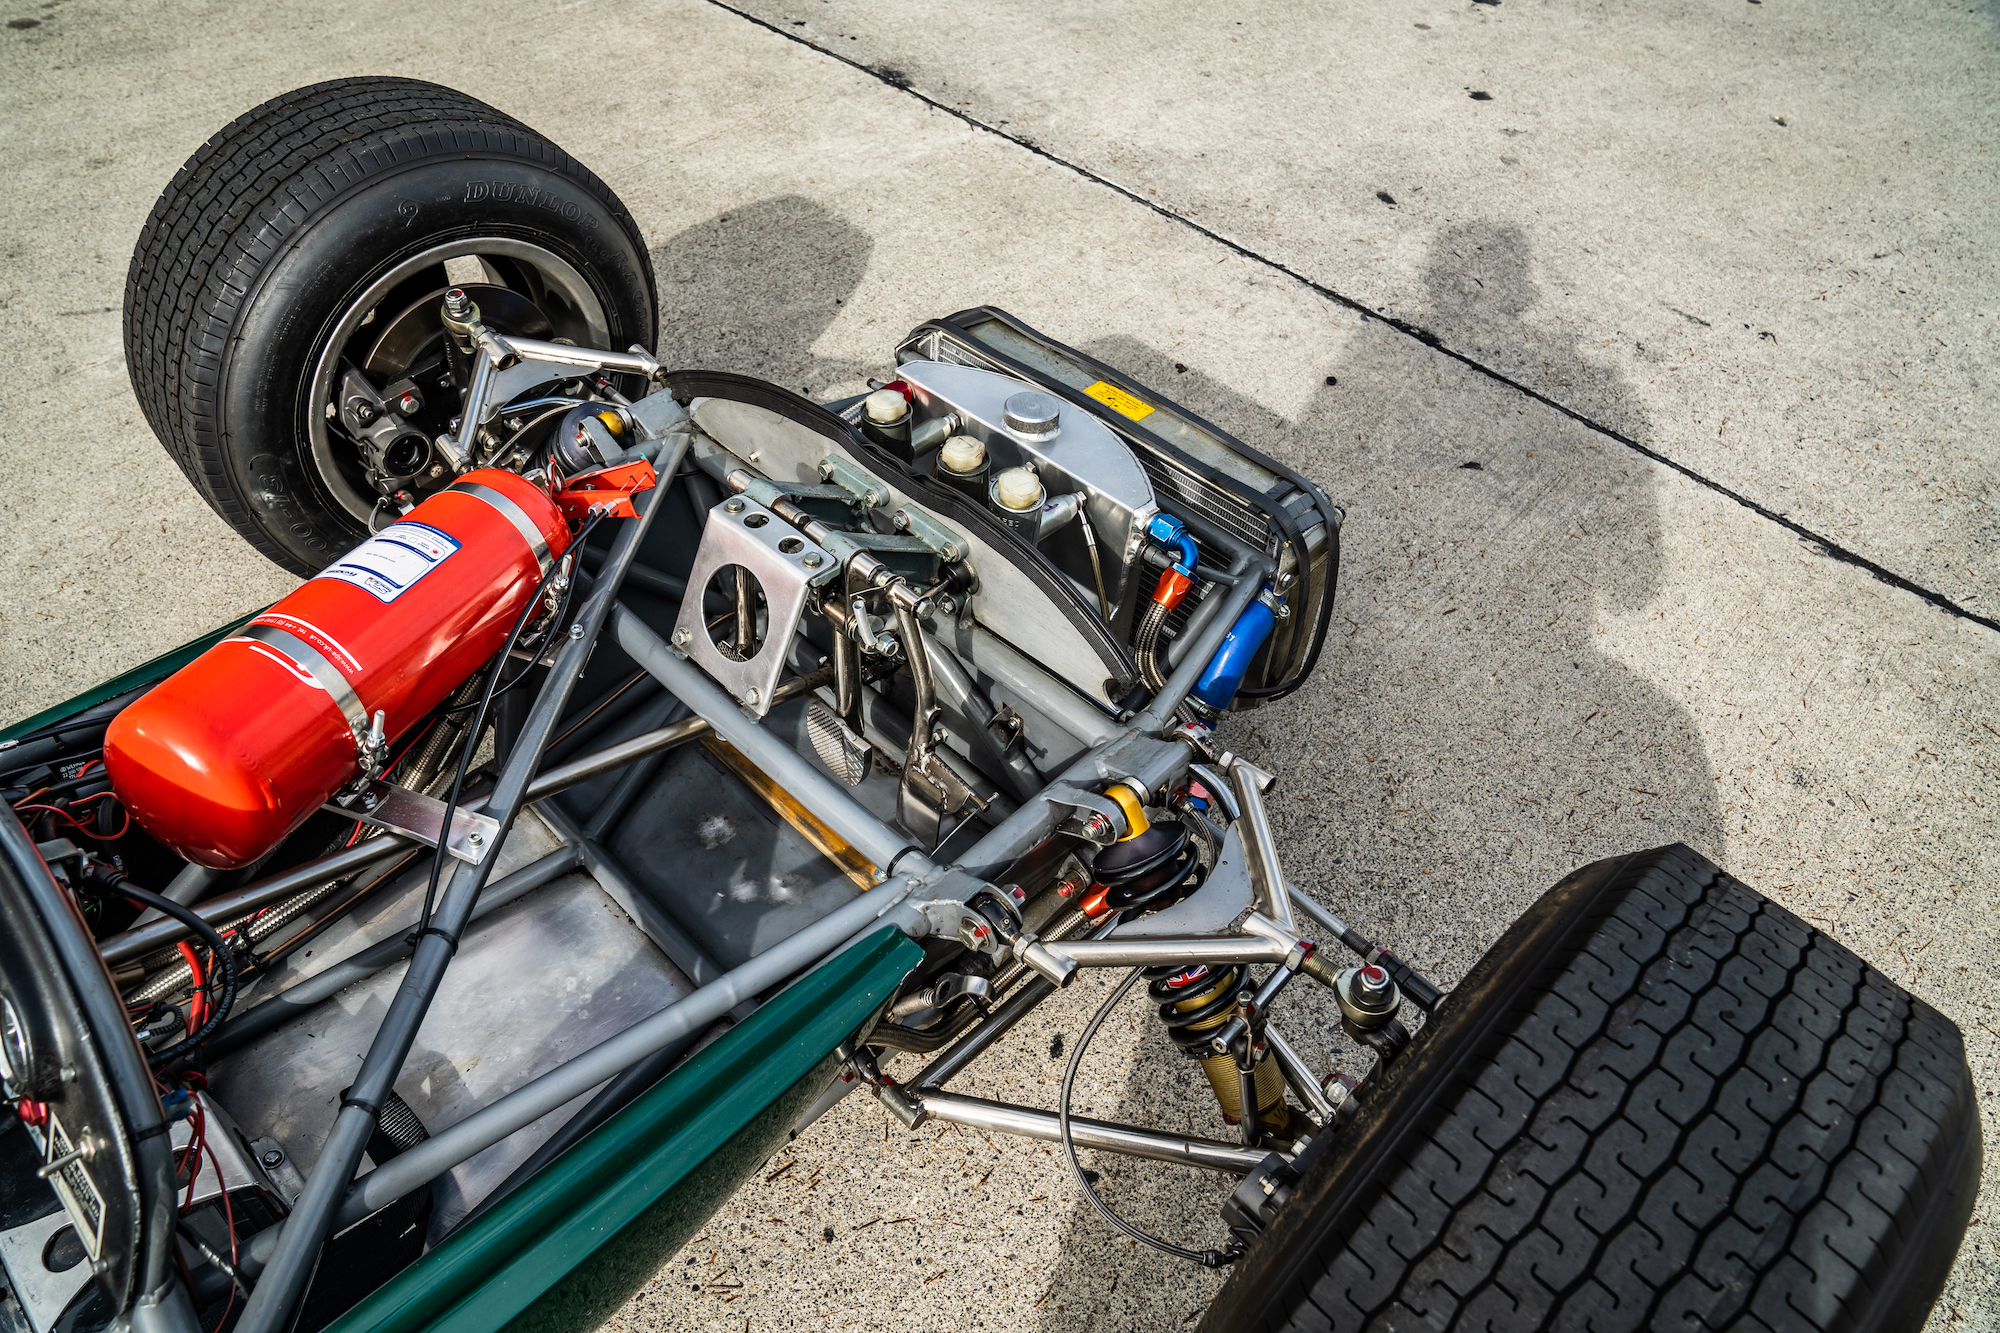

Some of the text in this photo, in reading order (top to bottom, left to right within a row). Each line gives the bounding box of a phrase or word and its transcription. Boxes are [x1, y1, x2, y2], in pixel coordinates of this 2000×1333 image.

[464, 181, 599, 231] DUNLOP
[612, 250, 651, 350] RACIN
[309, 634, 354, 675] www.spa-uk.co.uk
